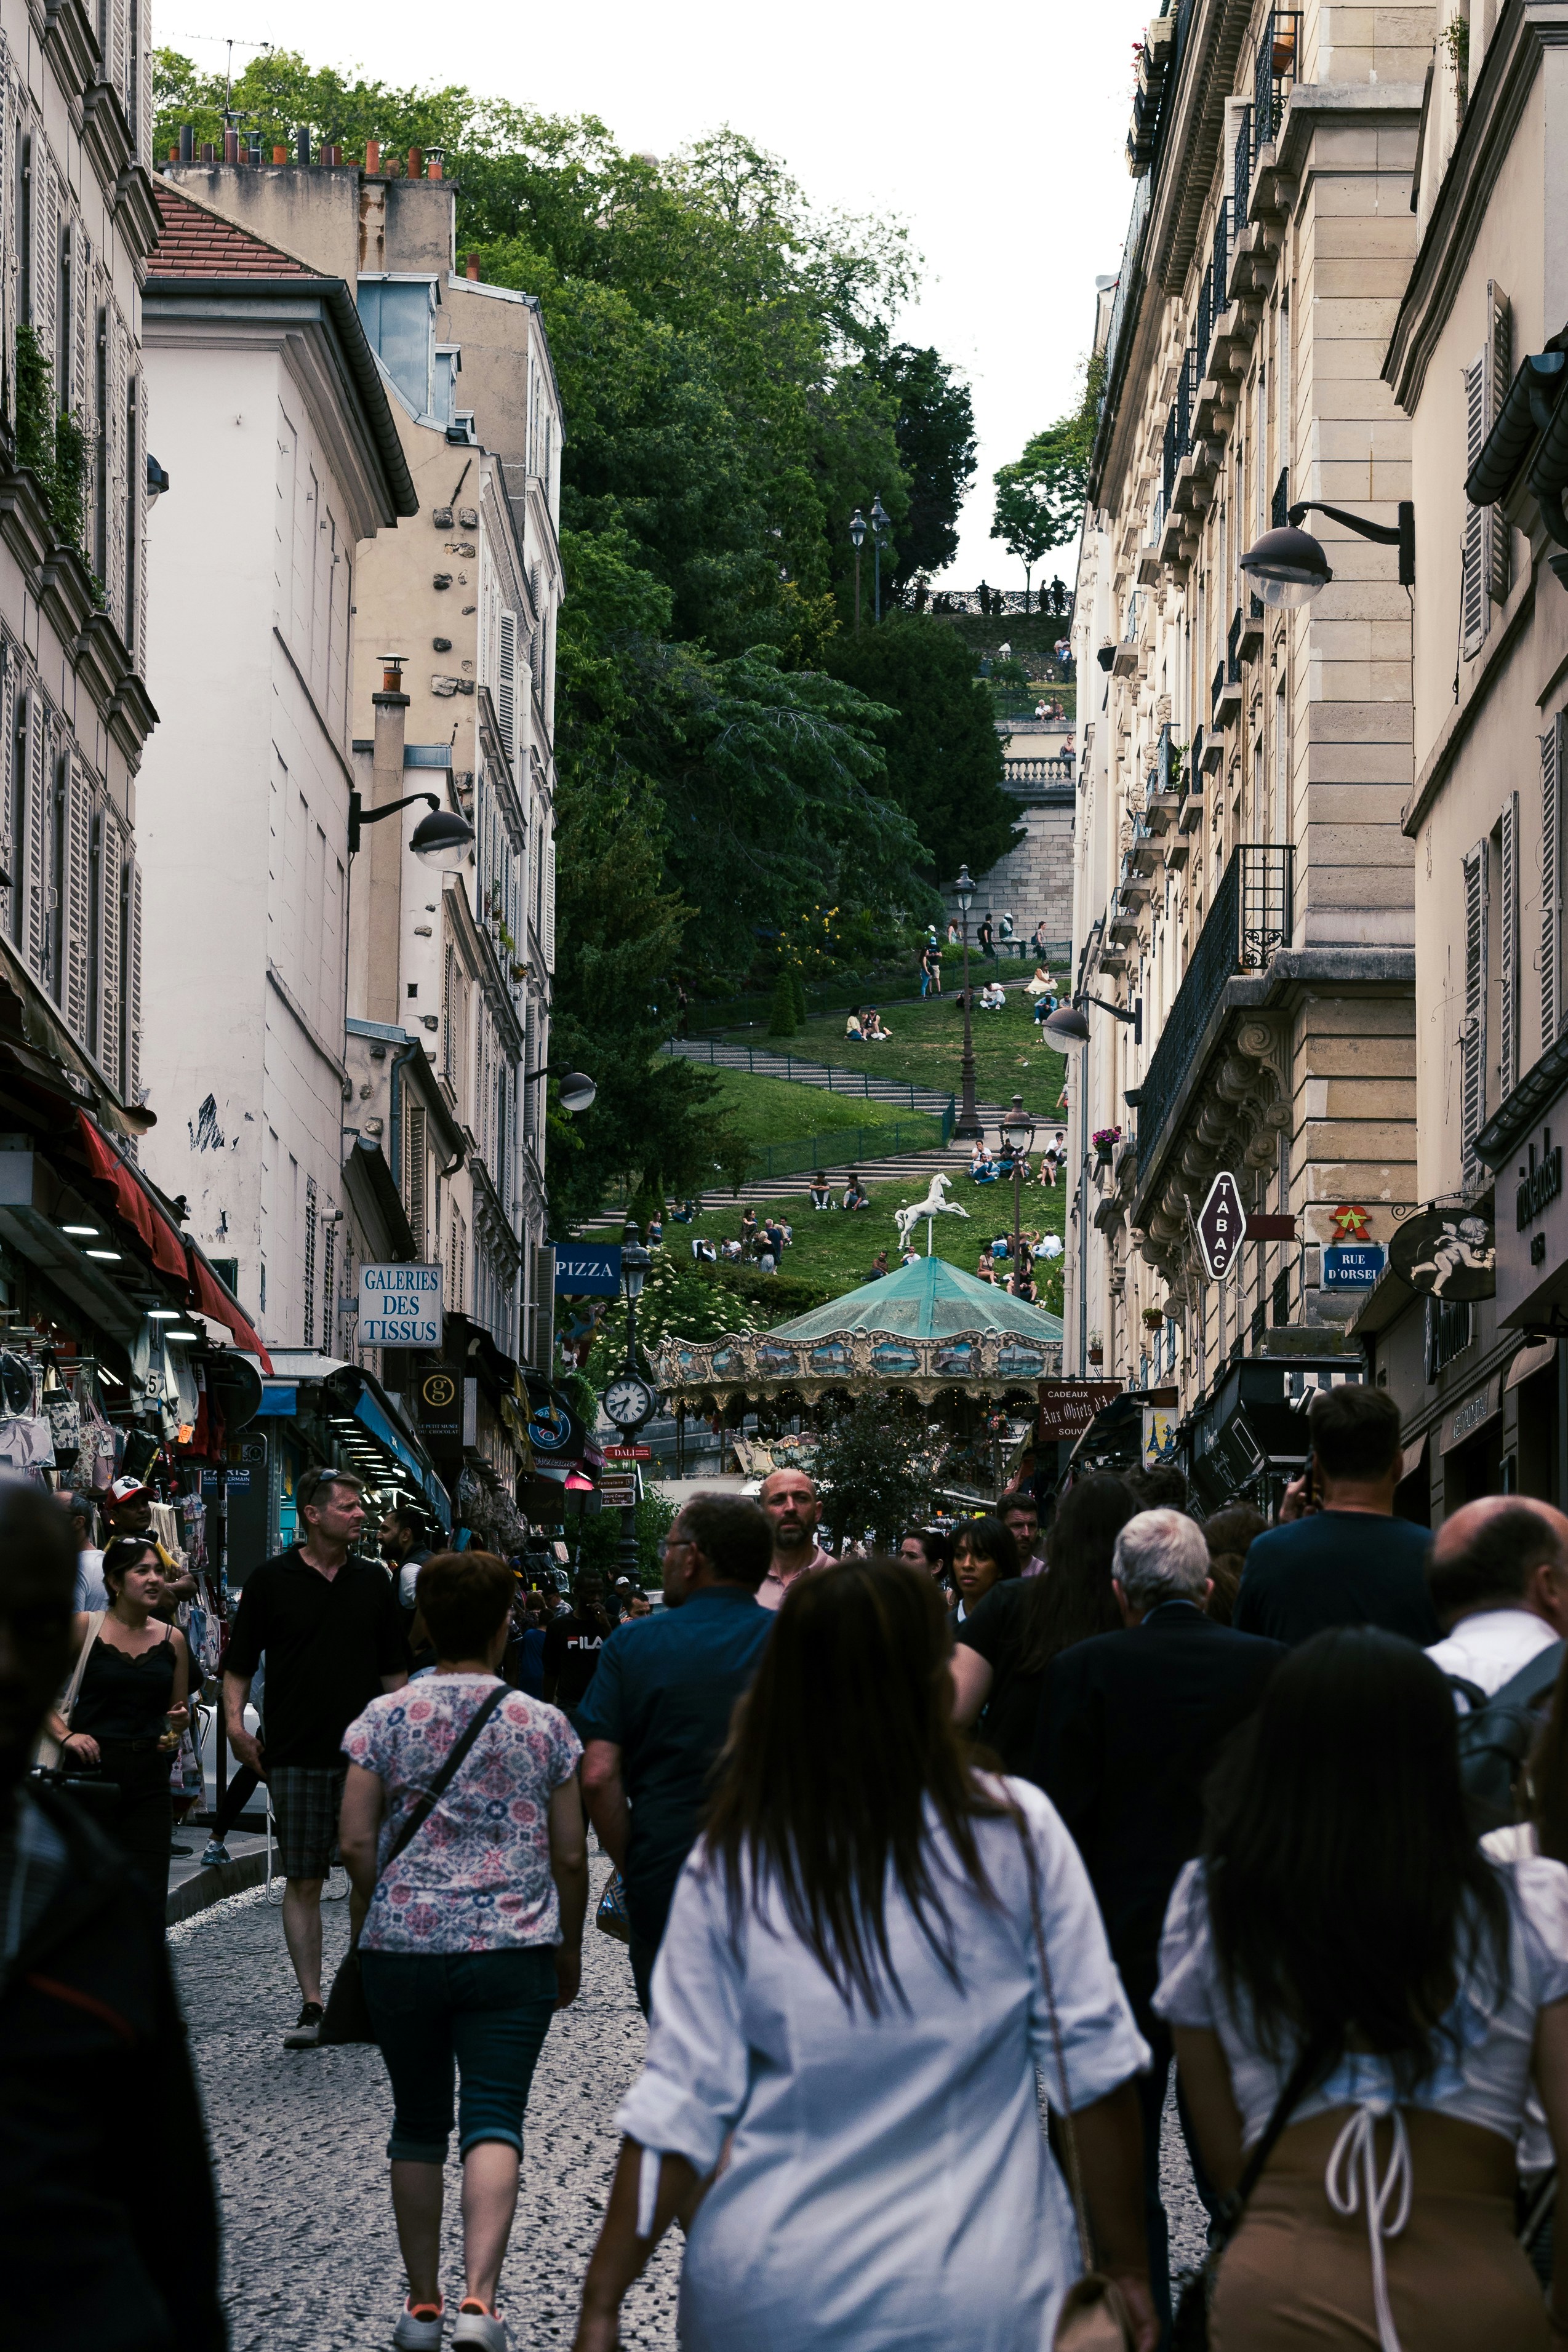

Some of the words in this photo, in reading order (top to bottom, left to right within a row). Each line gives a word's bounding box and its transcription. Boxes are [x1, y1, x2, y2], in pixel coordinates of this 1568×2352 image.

[1214, 1183, 1231, 1268] TABAC
[1342, 1254, 1366, 1265] RUE
[556, 1262, 614, 1278] PIZZA
[365, 1270, 438, 1291] GALERIES
[382, 1295, 420, 1316] DES
[364, 1320, 437, 1342] TISSUS
[148, 1374, 157, 1394] 5
[432, 1380, 447, 1401] g
[1044, 1407, 1062, 1425] Aux
[615, 1447, 635, 1457] DALÍ
[534, 1457, 577, 1468] Welcome
[567, 1635, 604, 1650] FILA
